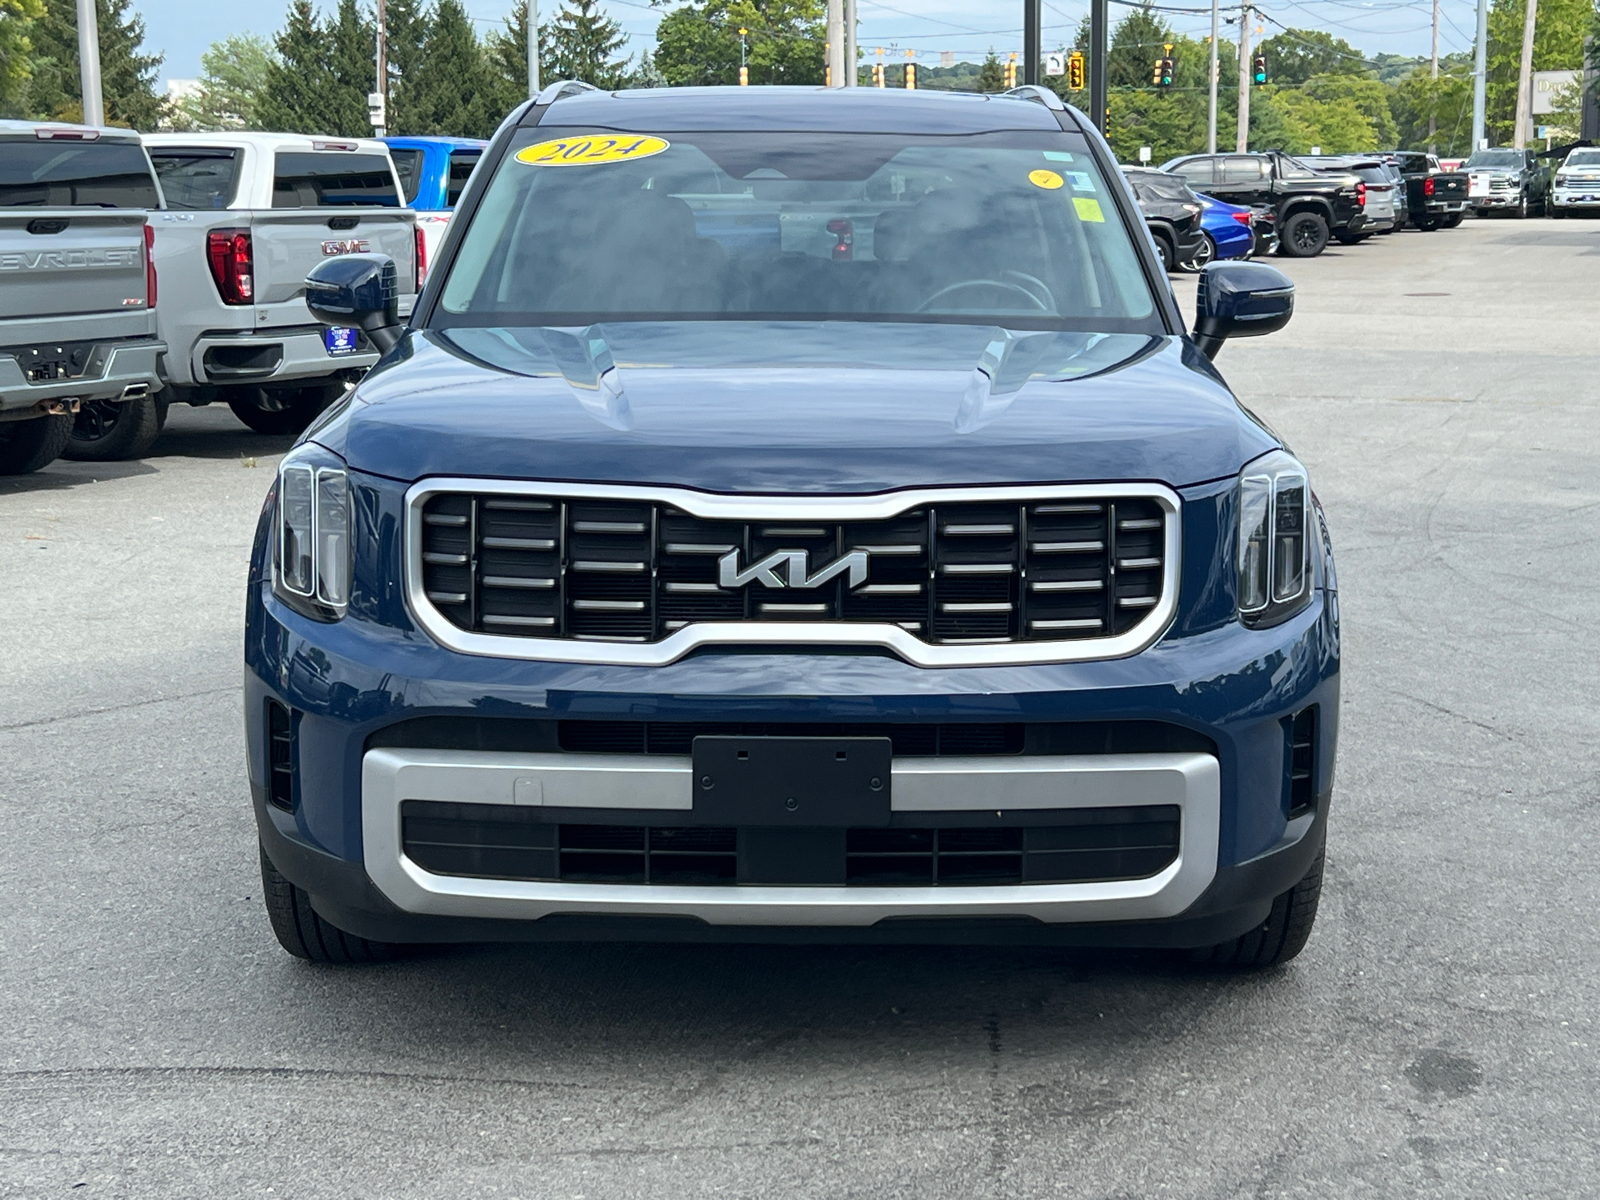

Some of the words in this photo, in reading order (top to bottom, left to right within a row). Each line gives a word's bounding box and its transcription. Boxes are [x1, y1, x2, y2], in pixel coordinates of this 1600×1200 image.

[534, 138, 647, 162] 2024
[321, 240, 371, 256] GMC
[718, 548, 869, 589] KIA
